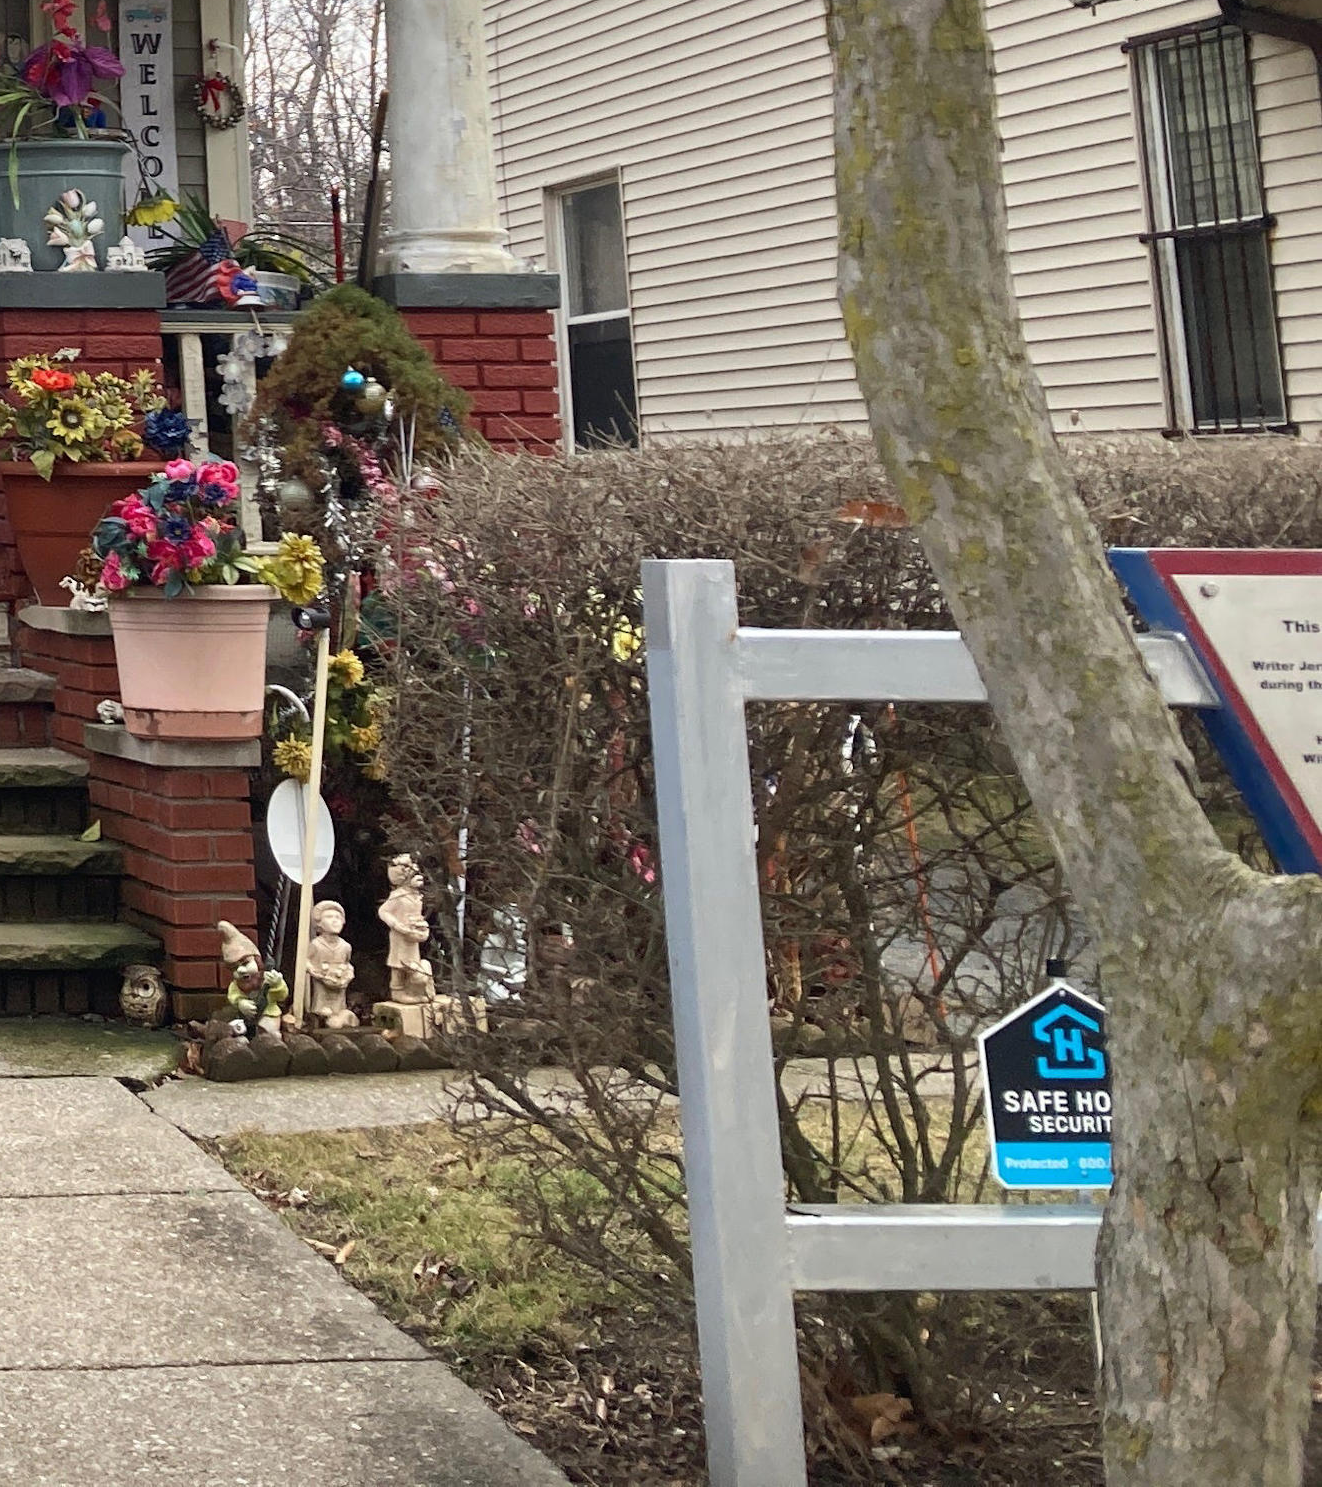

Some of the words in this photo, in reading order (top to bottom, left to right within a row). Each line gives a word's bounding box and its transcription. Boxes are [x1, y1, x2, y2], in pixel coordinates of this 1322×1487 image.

[1282, 619, 1320, 634] This
[1252, 661, 1294, 672] Writer
[1299, 661, 1322, 671] Jer
[1260, 680, 1303, 692] during
[1308, 680, 1322, 690] th
[1003, 1089, 1070, 1113] SAFE
[1075, 1090, 1112, 1113] HO
[1028, 1115, 1113, 1134] SECURIT
